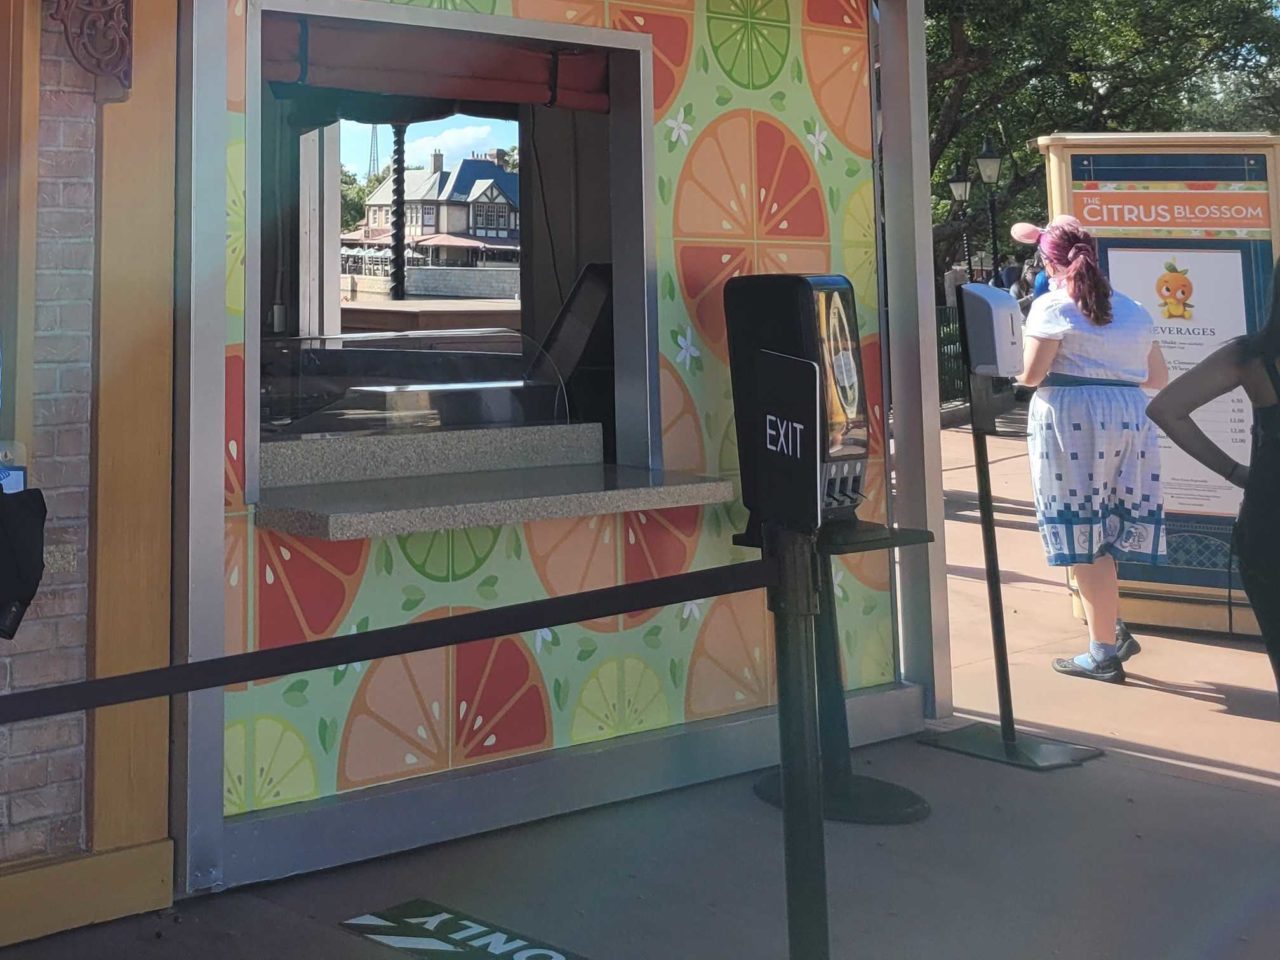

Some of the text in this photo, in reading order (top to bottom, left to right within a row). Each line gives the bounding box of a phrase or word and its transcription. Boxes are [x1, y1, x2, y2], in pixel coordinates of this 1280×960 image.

[1083, 204, 1263, 222] CITRUS BLOSSOM
[1150, 326, 1216, 336] EVERAGES
[766, 414, 804, 459] EXIT
